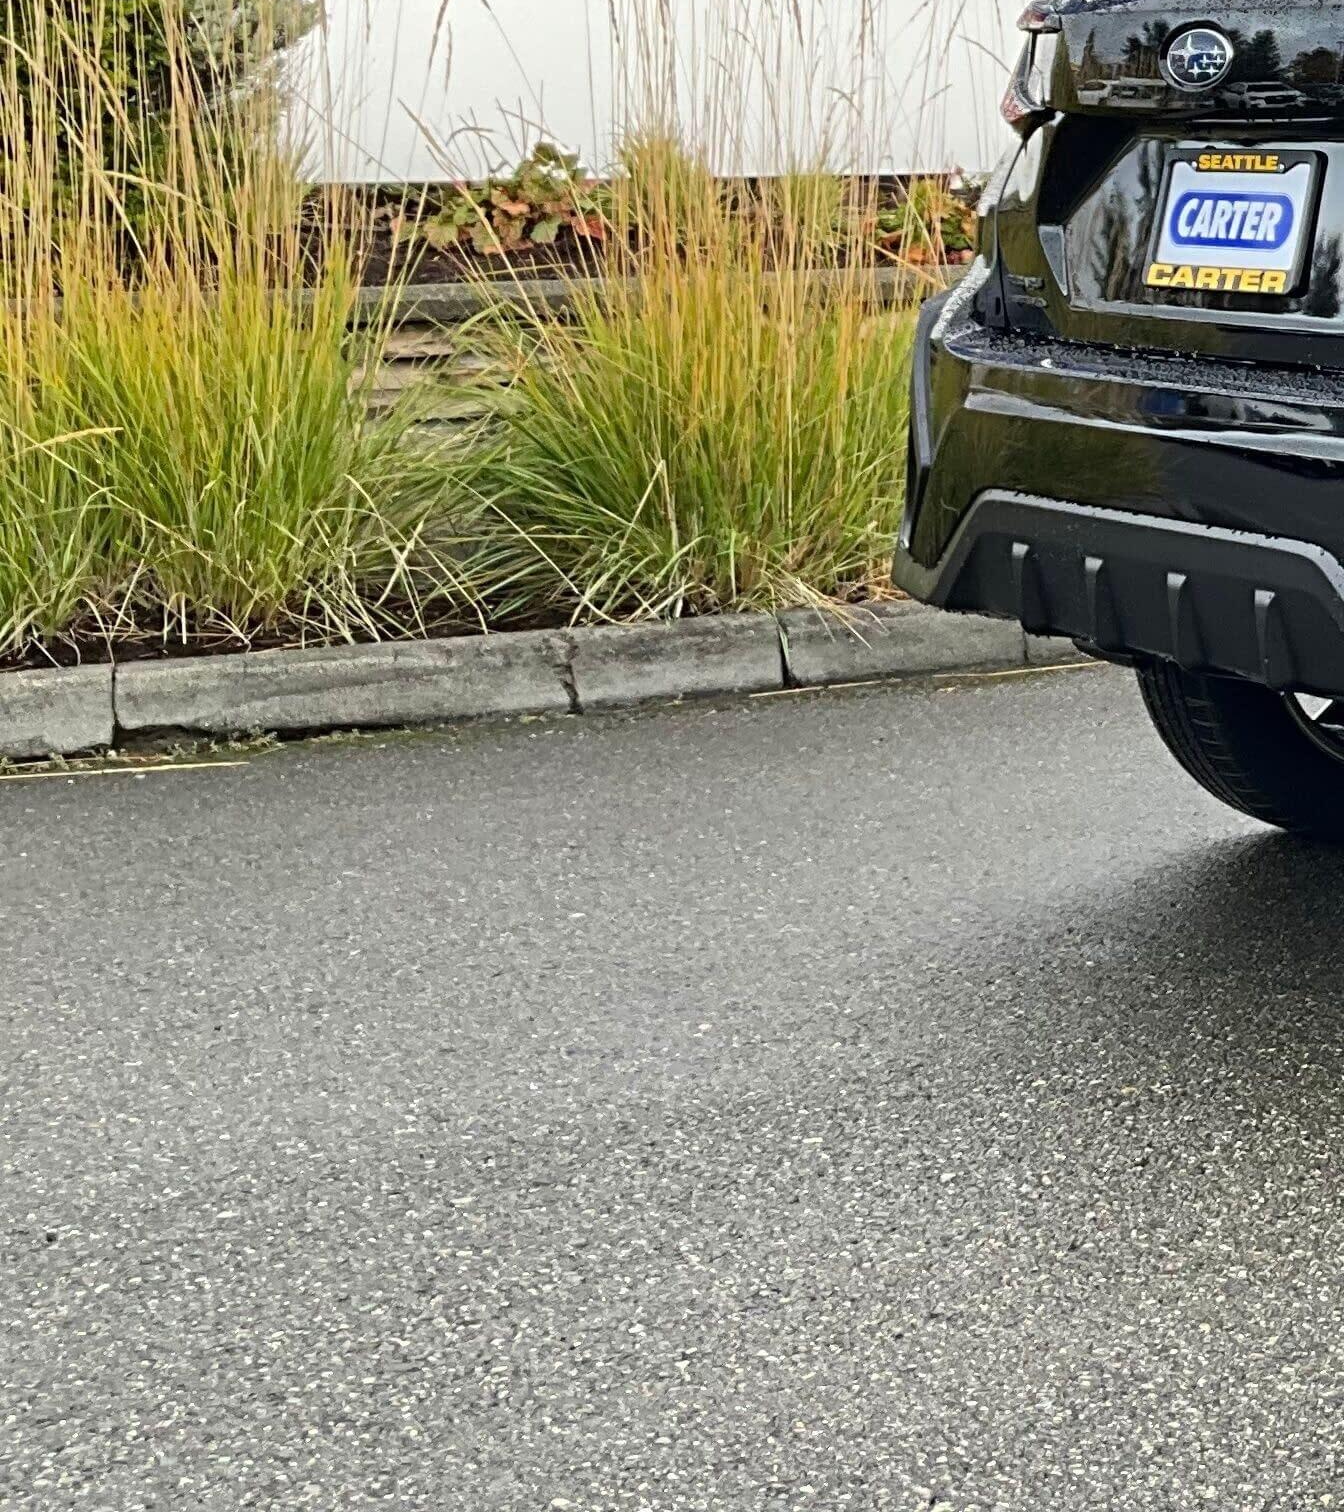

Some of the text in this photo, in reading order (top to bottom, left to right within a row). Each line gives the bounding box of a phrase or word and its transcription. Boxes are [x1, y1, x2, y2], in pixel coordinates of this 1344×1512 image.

[1197, 153, 1279, 171] SEATTLE
[1177, 197, 1283, 242] CARTER
[1147, 262, 1287, 294] CARTER
